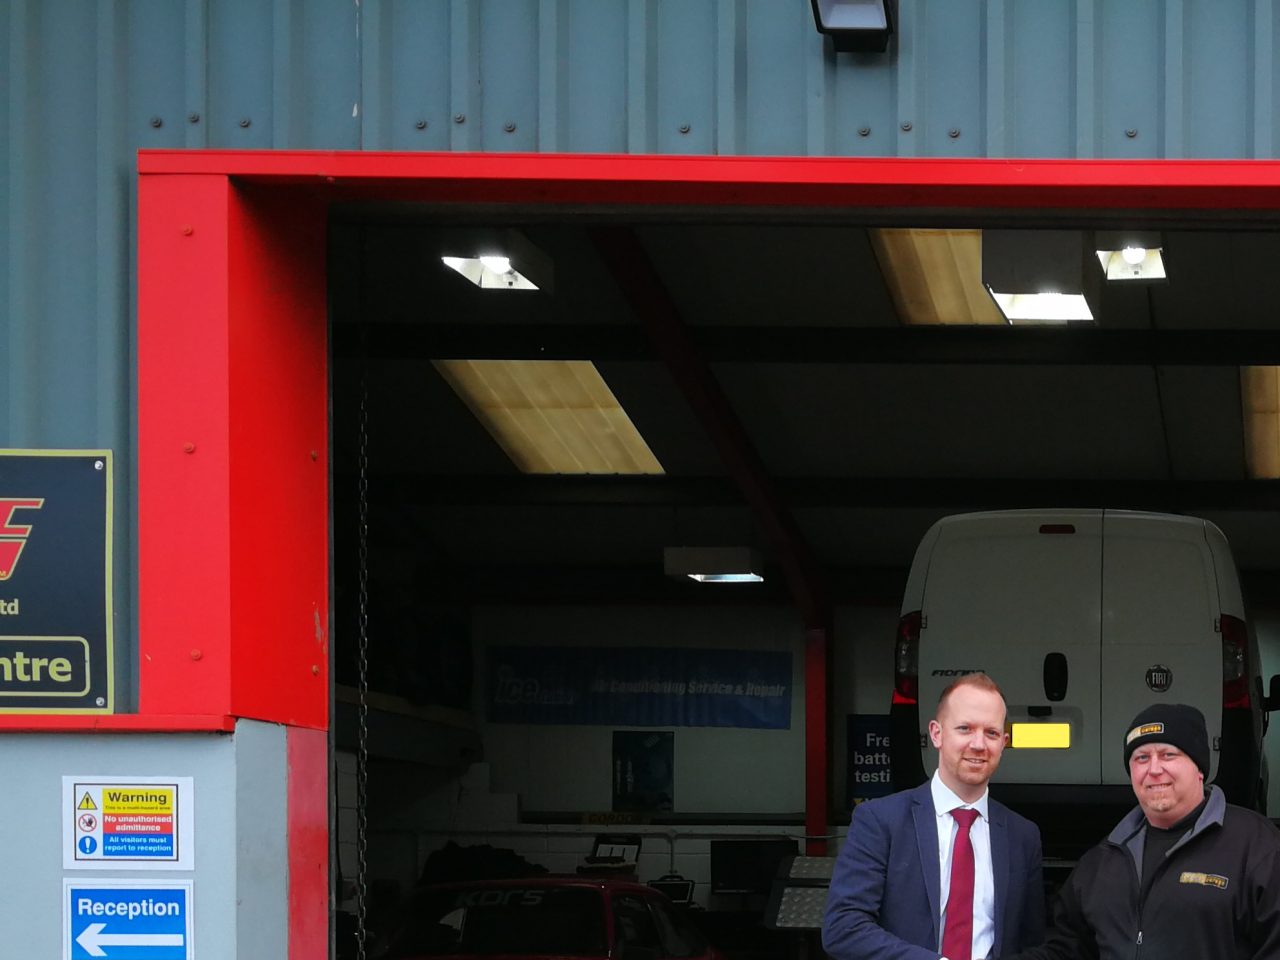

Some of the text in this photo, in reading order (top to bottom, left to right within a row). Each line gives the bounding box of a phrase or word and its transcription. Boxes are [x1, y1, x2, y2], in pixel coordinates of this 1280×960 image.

[688, 681, 732, 695] Service
[745, 682, 786, 698] Repair
[854, 752, 890, 765] batt
[108, 792, 167, 805] Warning
[105, 815, 172, 823] No unauthorised
[115, 824, 161, 832] admittance
[120, 836, 147, 844] visitors
[105, 844, 127, 852] report
[138, 844, 172, 852] reception
[78, 898, 180, 920] Reception
